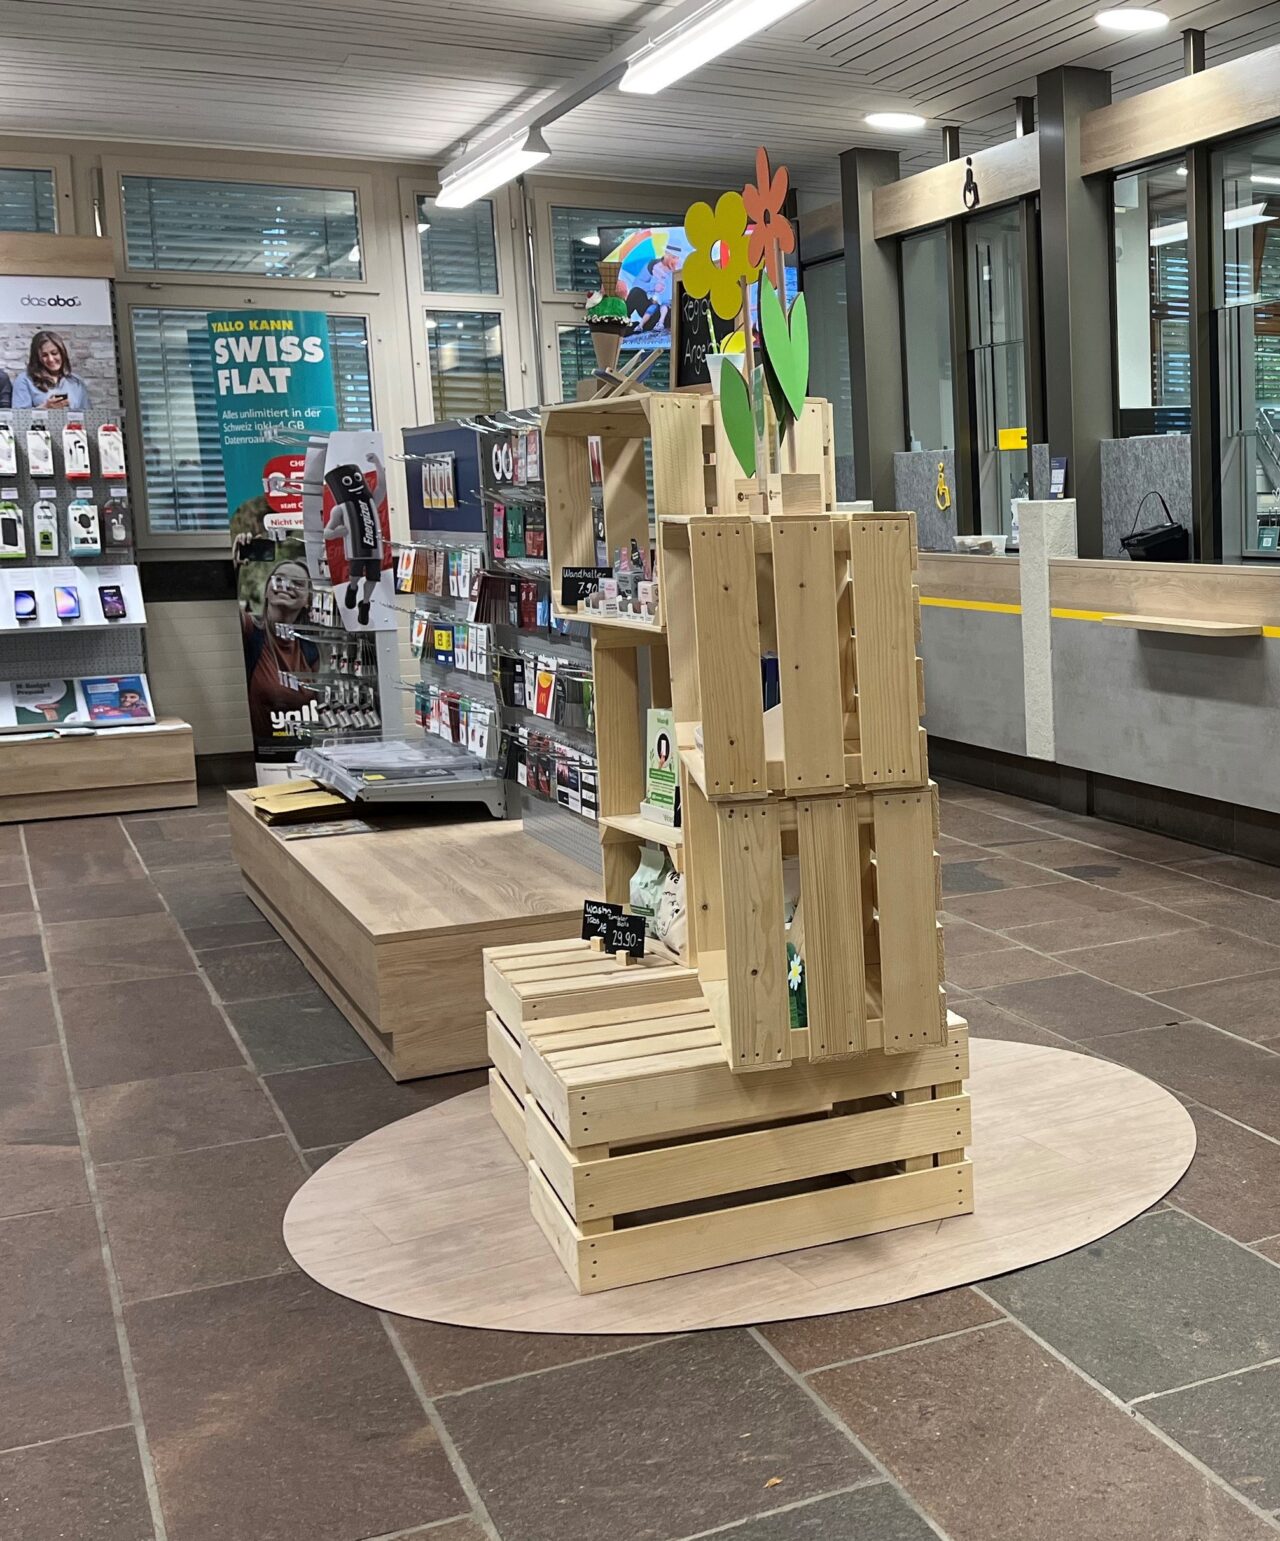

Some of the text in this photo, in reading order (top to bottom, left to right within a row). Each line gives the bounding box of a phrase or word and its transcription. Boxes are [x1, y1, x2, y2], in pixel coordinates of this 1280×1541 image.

[211, 319, 294, 333] YALLO KANN
[214, 335, 325, 365] SWISS
[217, 367, 292, 395] FLAT
[222, 407, 321, 419] Alles unlimitiert in der
[223, 421, 252, 432] Schweiz
[288, 420, 305, 430] GB
[358, 500, 375, 547] Energizer
